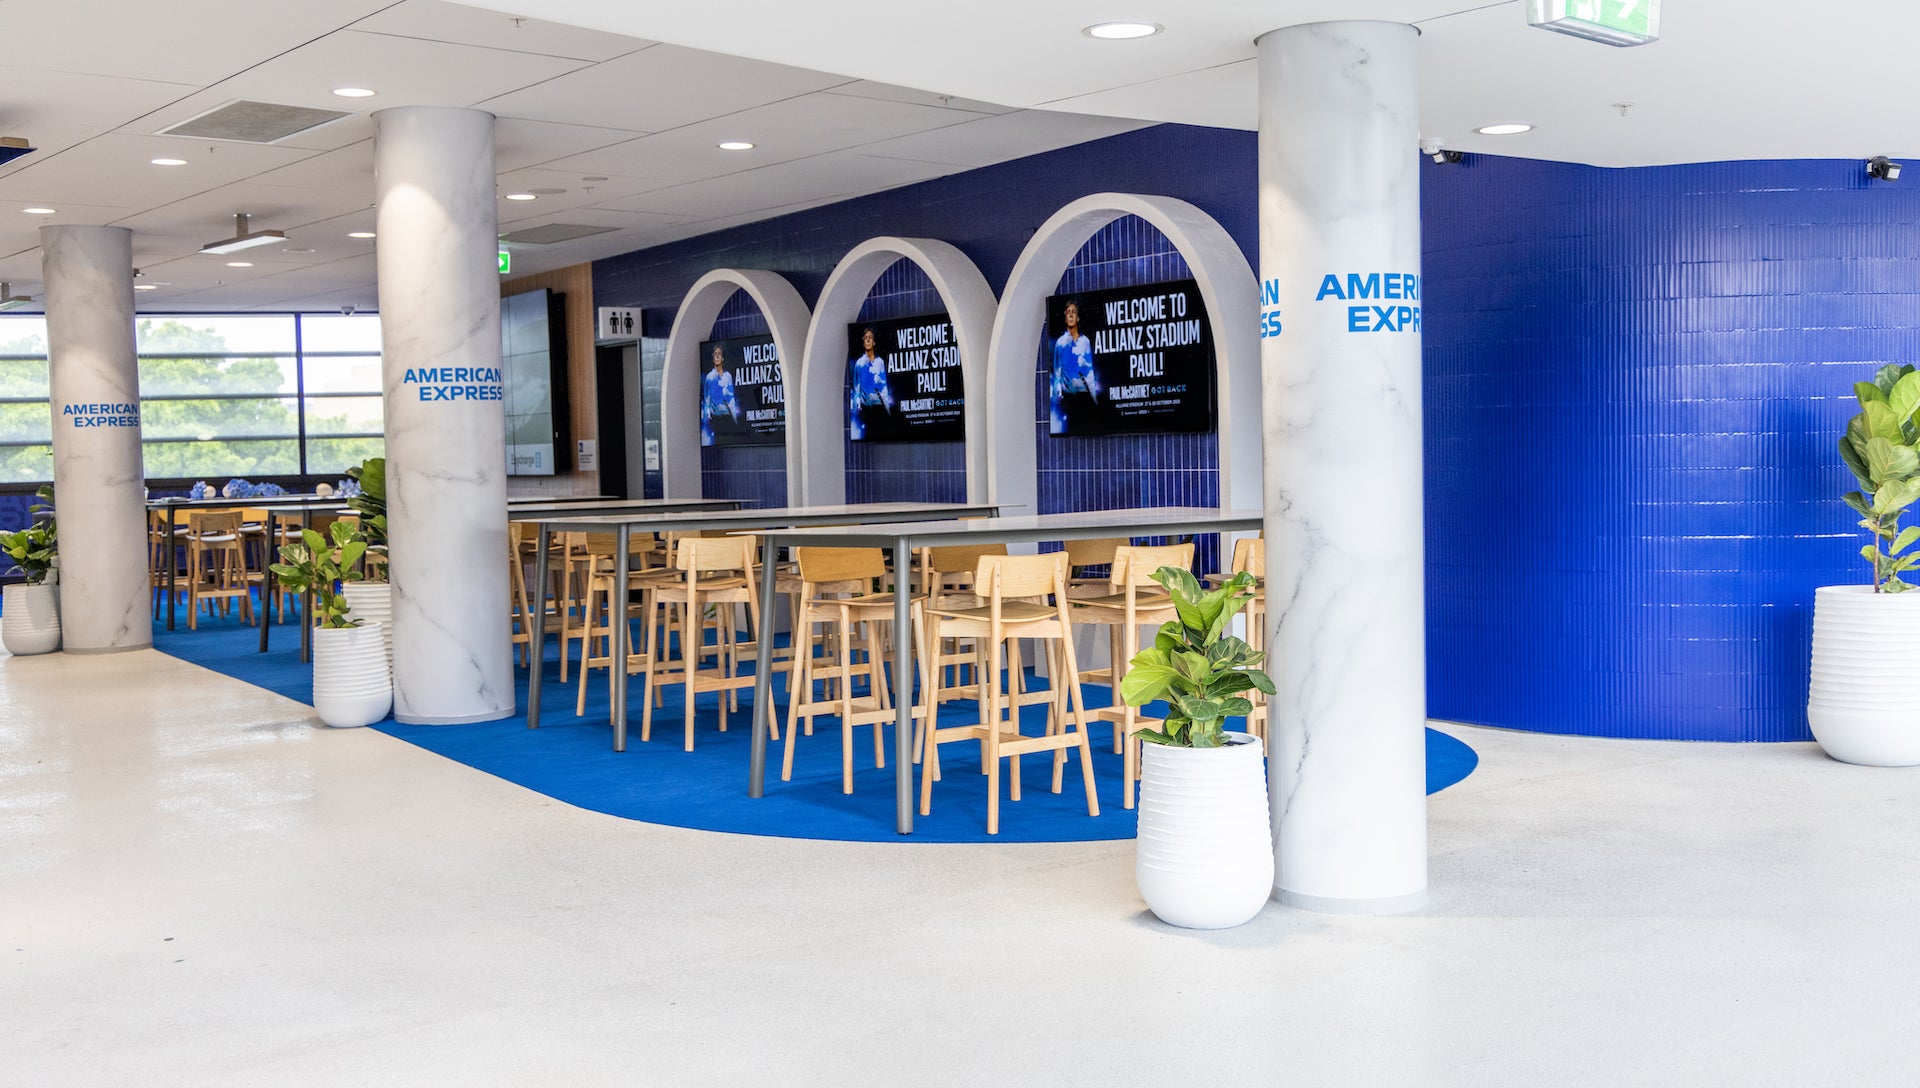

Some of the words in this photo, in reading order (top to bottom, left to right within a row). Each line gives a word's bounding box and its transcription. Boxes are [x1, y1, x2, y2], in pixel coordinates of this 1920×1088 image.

[1315, 273, 1422, 301] AMERI
[1105, 296, 1166, 325] WELCOME
[1169, 292, 1186, 318] TO
[1348, 306, 1421, 333] EXPR
[897, 323, 948, 349] WELCOME
[1094, 326, 1143, 354] ALLIANZ
[1146, 319, 1200, 348] STADIUM
[743, 343, 778, 365] WELCO
[888, 350, 929, 373] ALLIANZ
[931, 345, 961, 369] STADI
[1129, 352, 1163, 378] PAUL!
[403, 367, 502, 383] AMERICAN
[735, 364, 772, 386] ALLIANZ
[917, 371, 946, 393] PAUL!
[419, 385, 502, 401] EXPRESS
[762, 384, 784, 404] PAUL
[1151, 386, 1165, 394] GOT
[1167, 384, 1186, 393] BACK
[63, 403, 138, 415] AMERICAN
[74, 416, 139, 427] EXPRESS
